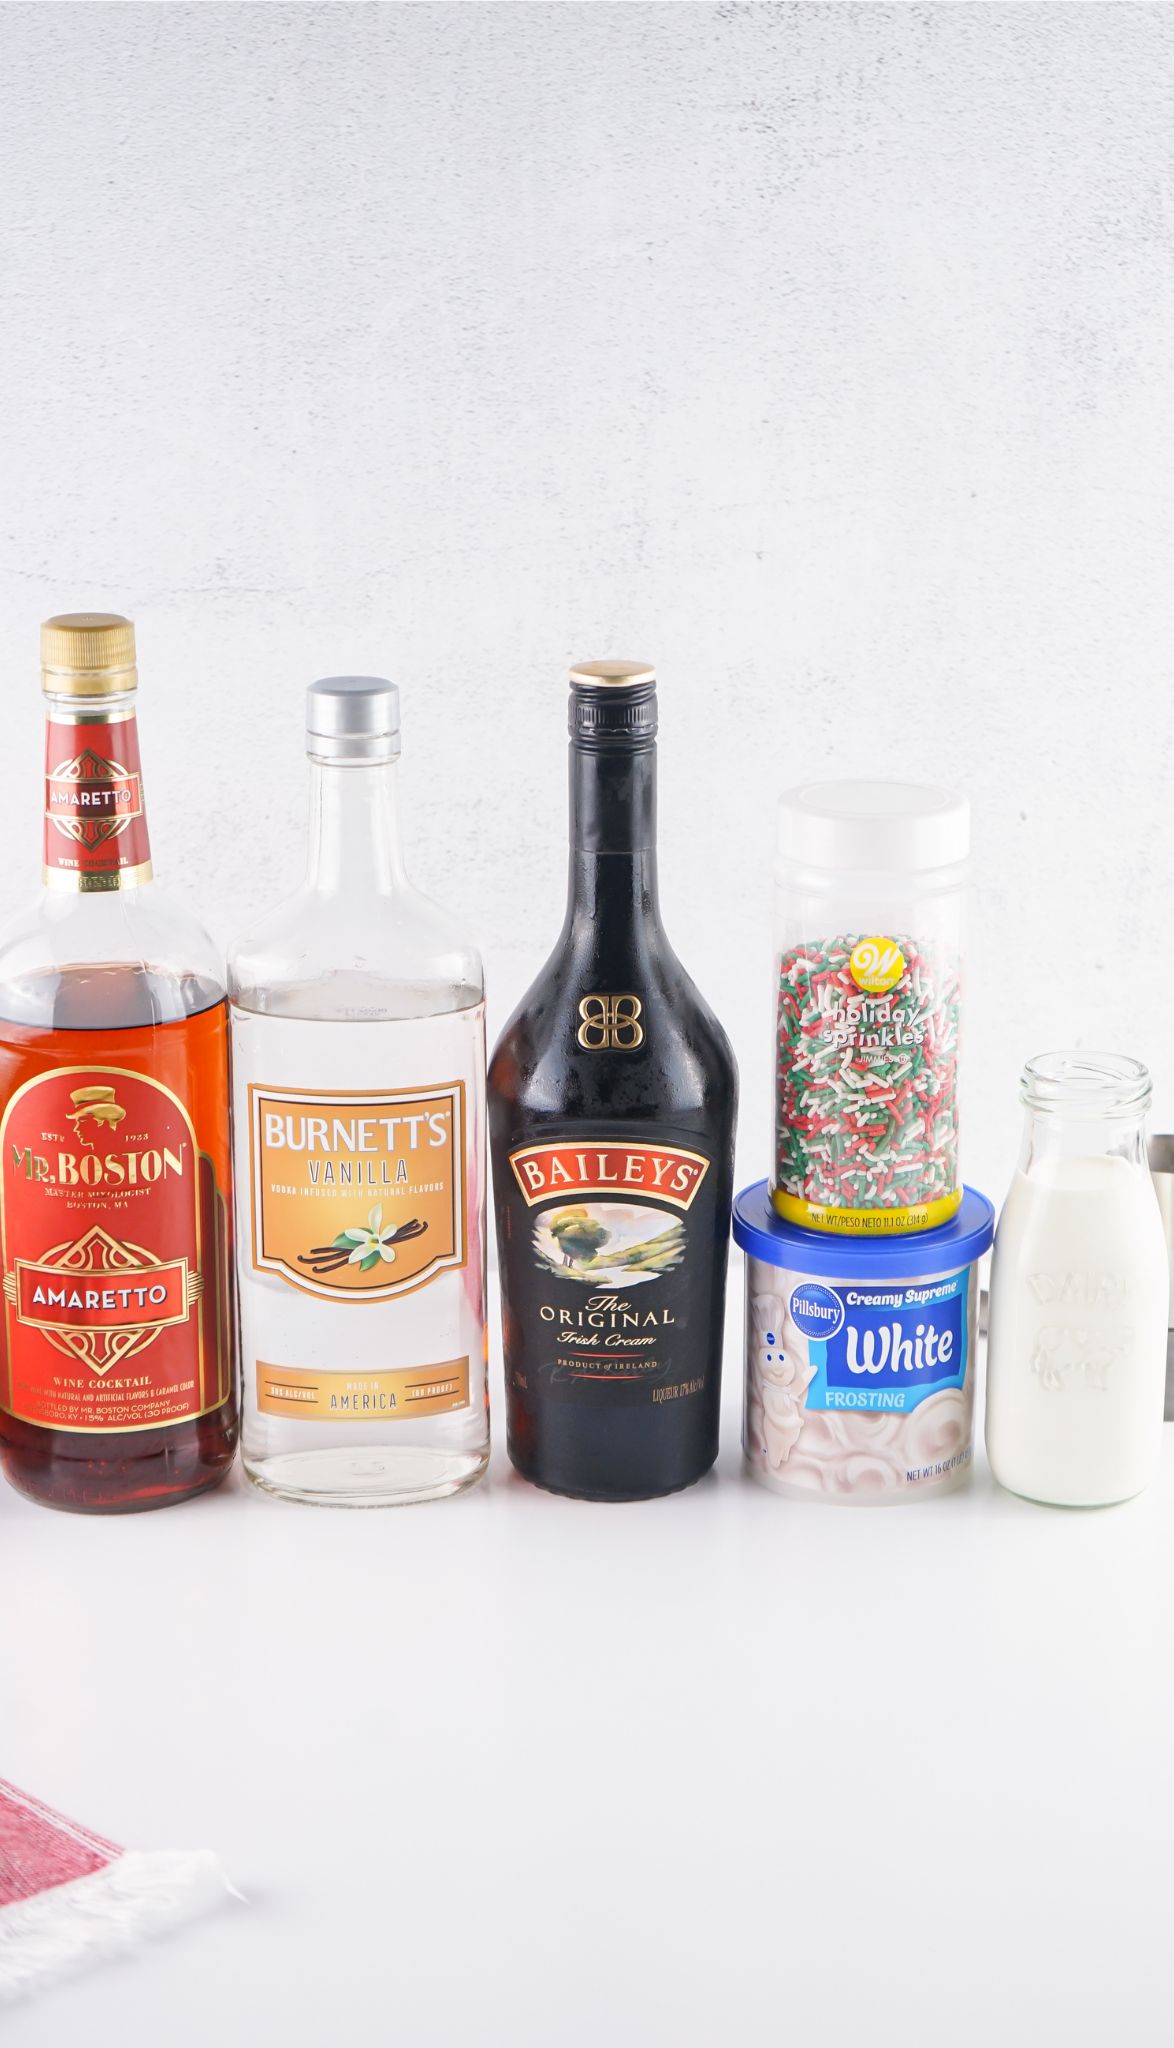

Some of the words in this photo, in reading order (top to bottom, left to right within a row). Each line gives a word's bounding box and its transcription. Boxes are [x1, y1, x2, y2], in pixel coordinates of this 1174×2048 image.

[51, 789, 132, 806] AMARETTO
[58, 857, 80, 867] WINE
[858, 974, 896, 987] wilton
[832, 1001, 921, 1027] holiday
[823, 1026, 924, 1048] sprinkles
[858, 1055, 894, 1063] JIMMIES
[264, 1111, 449, 1152] BURNETT'S
[58, 1144, 184, 1186] BOSTON
[307, 1159, 409, 1185] VANILLA
[522, 1153, 694, 1192] BAILEYS
[44, 1187, 84, 1199] MASTER
[271, 1183, 297, 1196] VODKA
[408, 1182, 445, 1195] FLAVORS
[66, 1201, 112, 1210] BOSTON,
[114, 1201, 129, 1210] MA
[811, 1213, 824, 1223] NET
[826, 1215, 861, 1228] WT/PESO
[862, 1217, 882, 1228] NETO
[883, 1217, 894, 1227] 11.1
[895, 1216, 905, 1227] OZ
[32, 1285, 168, 1309] AMARETTO
[846, 1291, 902, 1308] Creamy
[905, 1281, 957, 1304] Supreme
[584, 1295, 632, 1312] The
[792, 1297, 841, 1325] Pillsbury
[540, 1306, 676, 1328] ORIGINAL
[556, 1331, 600, 1346] Irish
[604, 1334, 657, 1347] Cream
[846, 1322, 953, 1374] White
[556, 1358, 601, 1370] PRODUCT
[603, 1362, 613, 1371] of
[614, 1361, 658, 1370] IRELAND
[53, 1376, 84, 1389] WINE
[88, 1375, 152, 1389] COCKTAIL
[345, 1382, 367, 1391] MADE
[370, 1382, 379, 1390] IN
[57, 1391, 81, 1401] NATURAL
[82, 1393, 95, 1402] AND
[96, 1393, 125, 1402] ARTIFICIAL
[126, 1389, 149, 1401] FLAVORS
[155, 1383, 179, 1397] CARAMEL
[652, 1385, 679, 1404] LIQUEUR
[825, 1392, 905, 1407] FROSTING
[69, 1405, 79, 1413] BY
[80, 1406, 94, 1414] MR.
[96, 1406, 130, 1414] BOSTON
[130, 1400, 171, 1412] COMPANY
[330, 1393, 397, 1410] AMERICA
[84, 1414, 104, 1422] 15%
[107, 1412, 143, 1422] ALC/VOL
[144, 1409, 160, 1419] (30
[161, 1402, 190, 1415] PROOF)
[906, 1469, 920, 1482] NET
[922, 1465, 933, 1479] WT
[935, 1463, 942, 1476] 16
[942, 1459, 950, 1472] OZ
